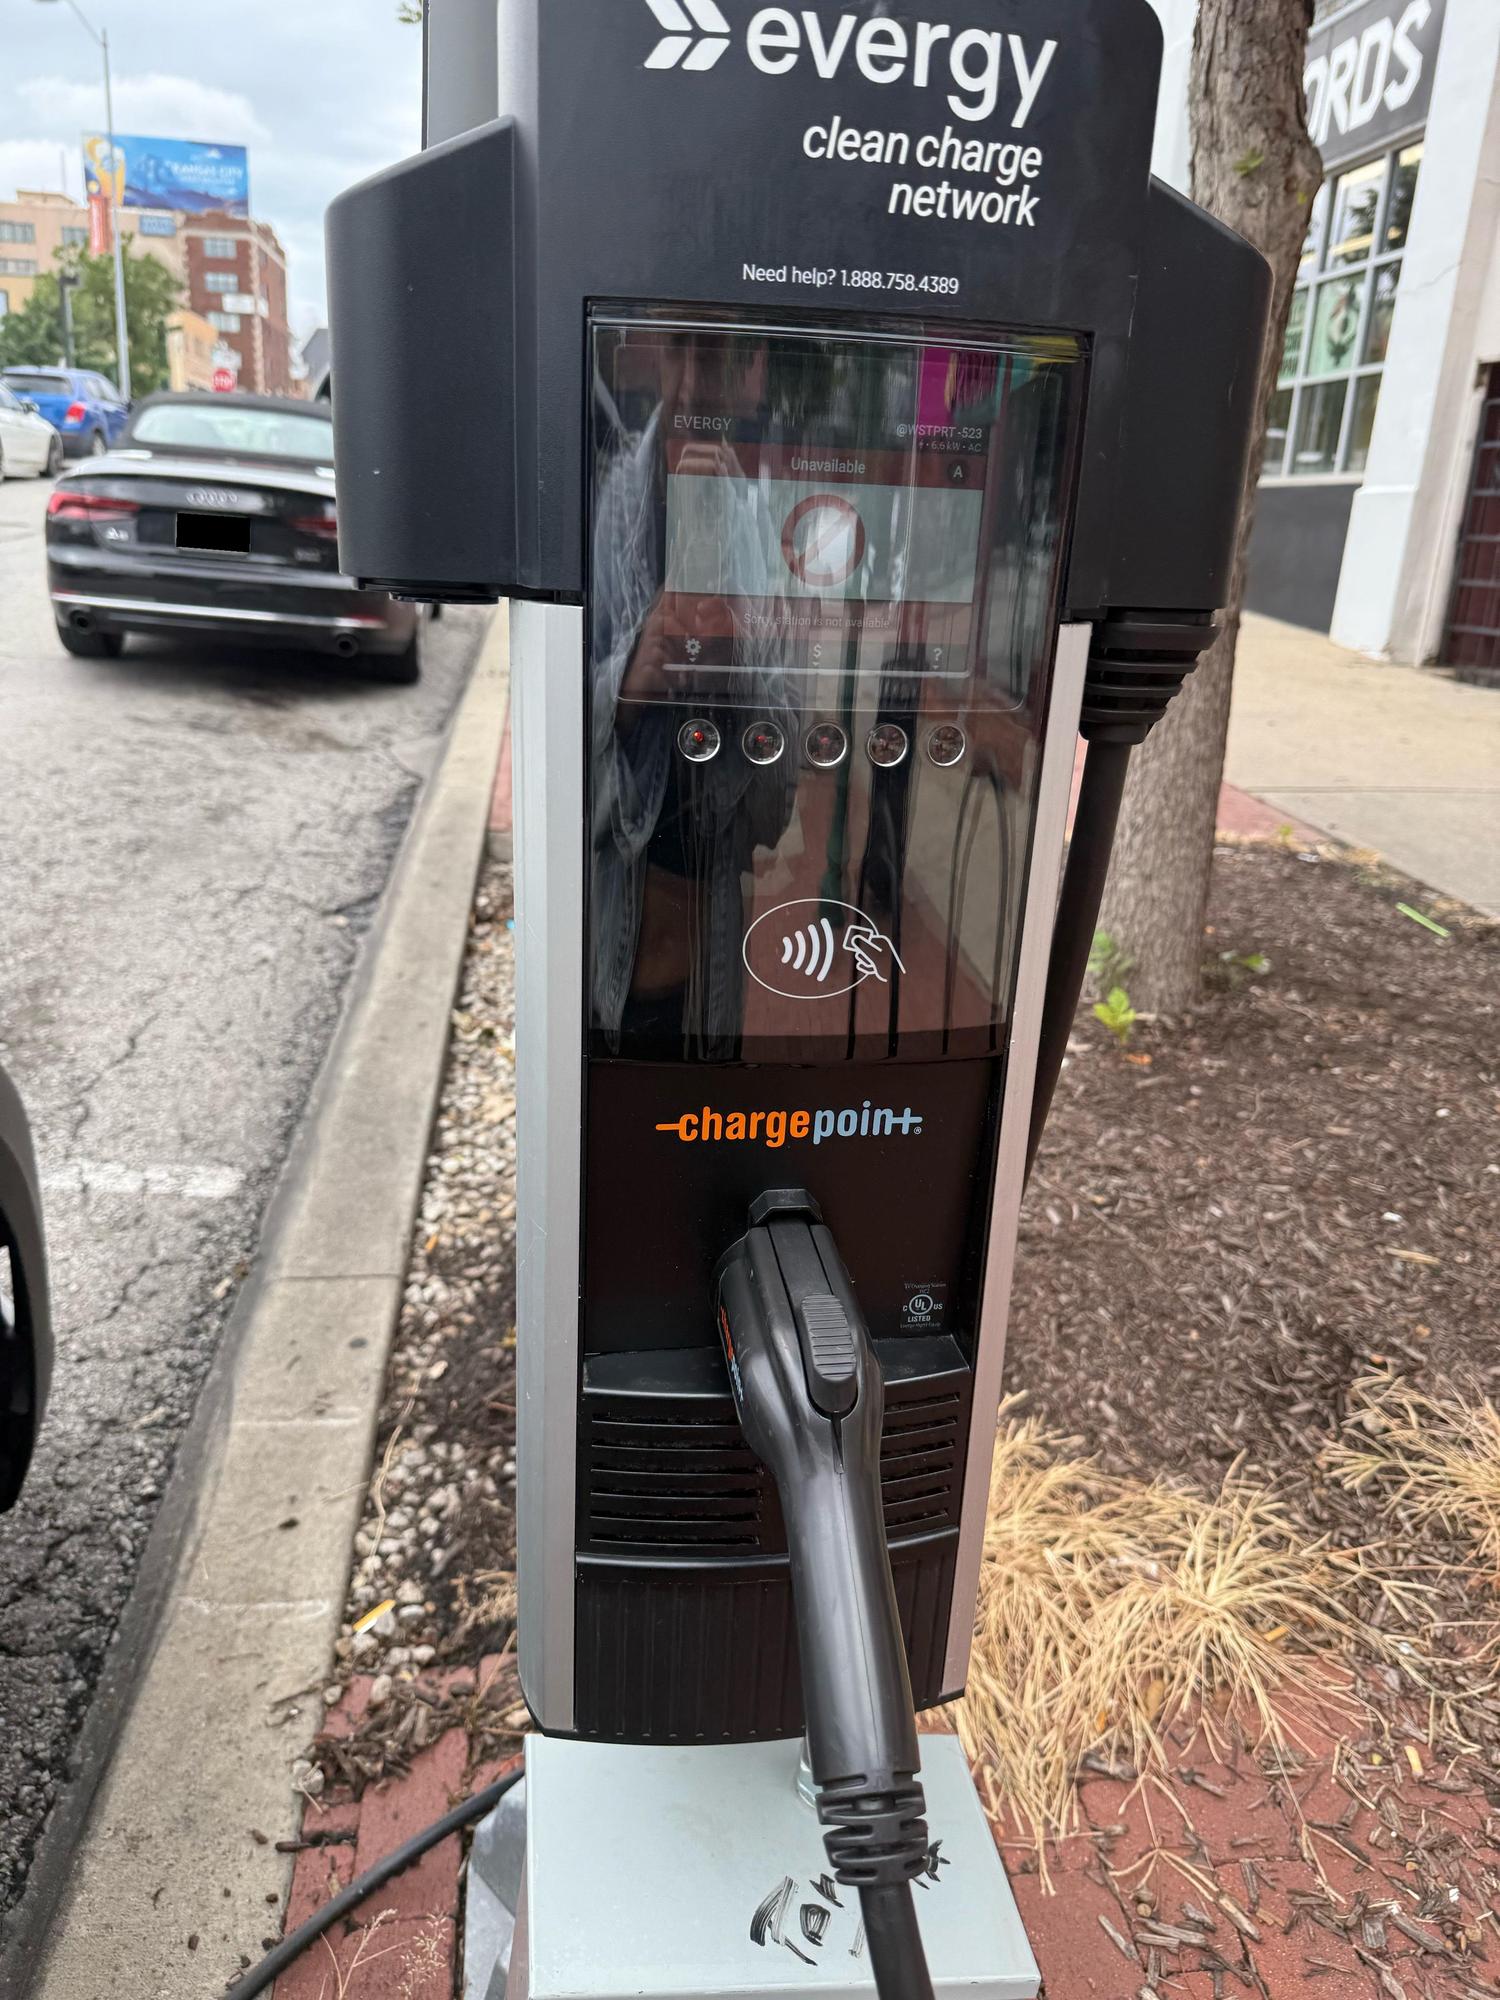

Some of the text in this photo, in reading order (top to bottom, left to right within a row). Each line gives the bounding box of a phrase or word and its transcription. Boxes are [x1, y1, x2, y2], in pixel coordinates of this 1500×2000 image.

[746, 7, 1058, 128] evergy
[803, 115, 1043, 186] clean charge
[888, 181, 1041, 227] network
[742, 264, 960, 294] Need help? 1.888.758.4389
[673, 415, 732, 431] EVERGY
[791, 457, 866, 474] Unavailable
[953, 465, 963, 478] A
[743, 613, 890, 629] Sorry, station is not available
